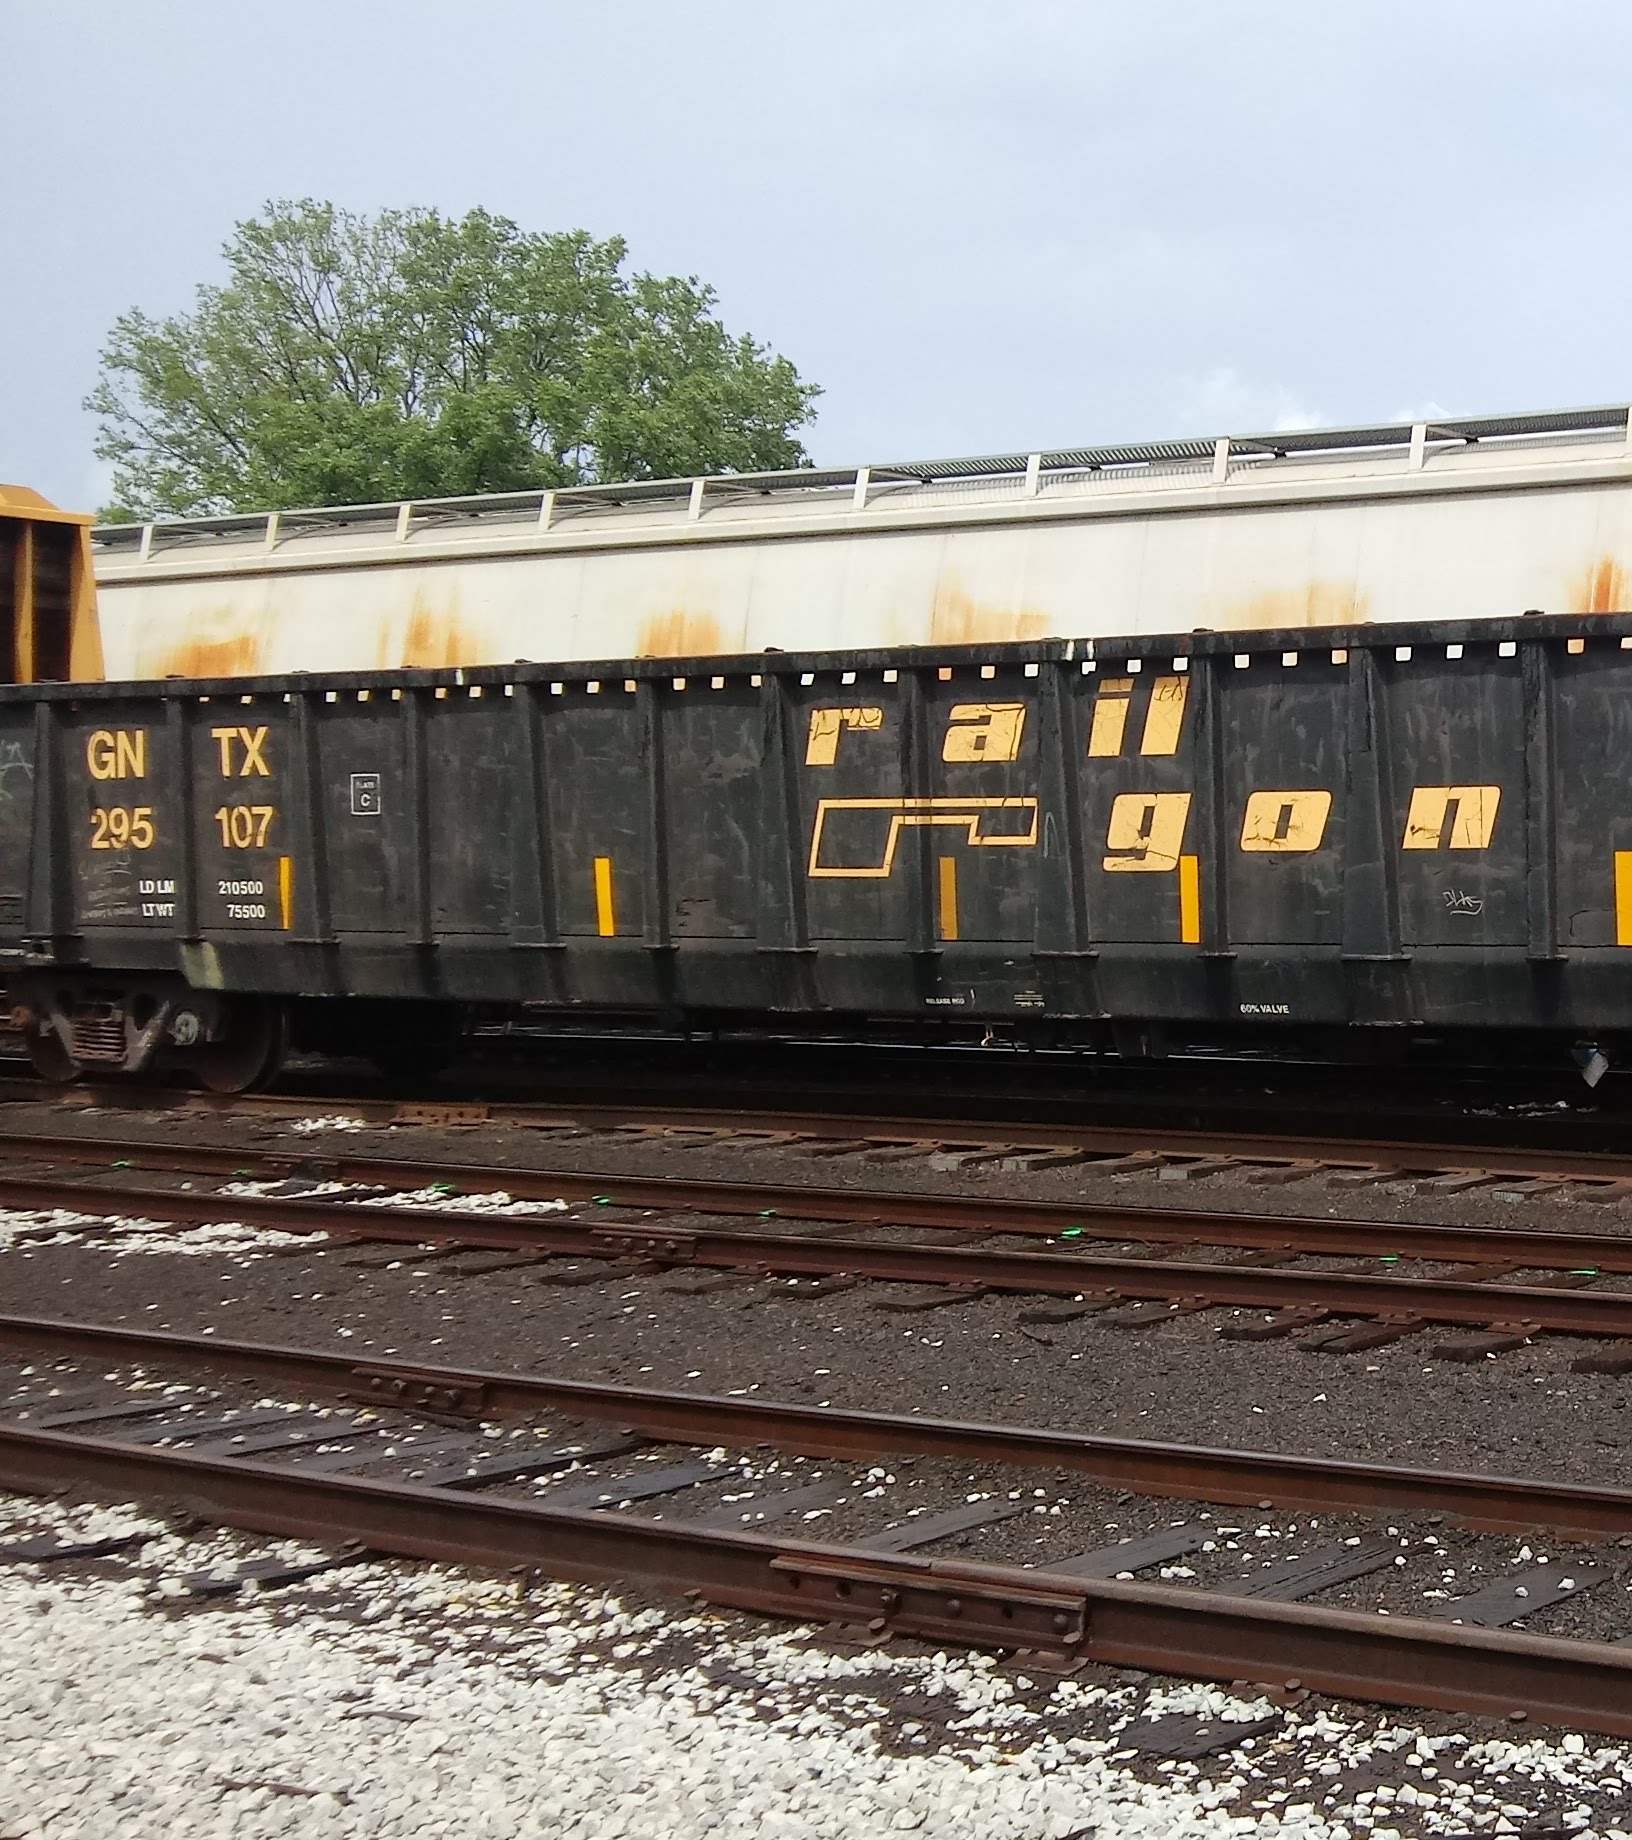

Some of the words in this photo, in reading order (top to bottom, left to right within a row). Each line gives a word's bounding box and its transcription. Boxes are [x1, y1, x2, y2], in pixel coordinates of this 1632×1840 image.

[805, 675, 1190, 766] rail
[86, 729, 145, 780] GN
[211, 726, 270, 777] TX
[360, 793, 371, 807] C
[90, 807, 154, 849] 295
[214, 805, 274, 848] 107
[1102, 785, 1502, 873] gon
[139, 880, 154, 894] LD
[218, 880, 264, 895] 210500
[142, 904, 154, 917] LT
[155, 904, 175, 918] WT
[226, 904, 266, 918] 75500
[1260, 1004, 1290, 1014] VALVE
